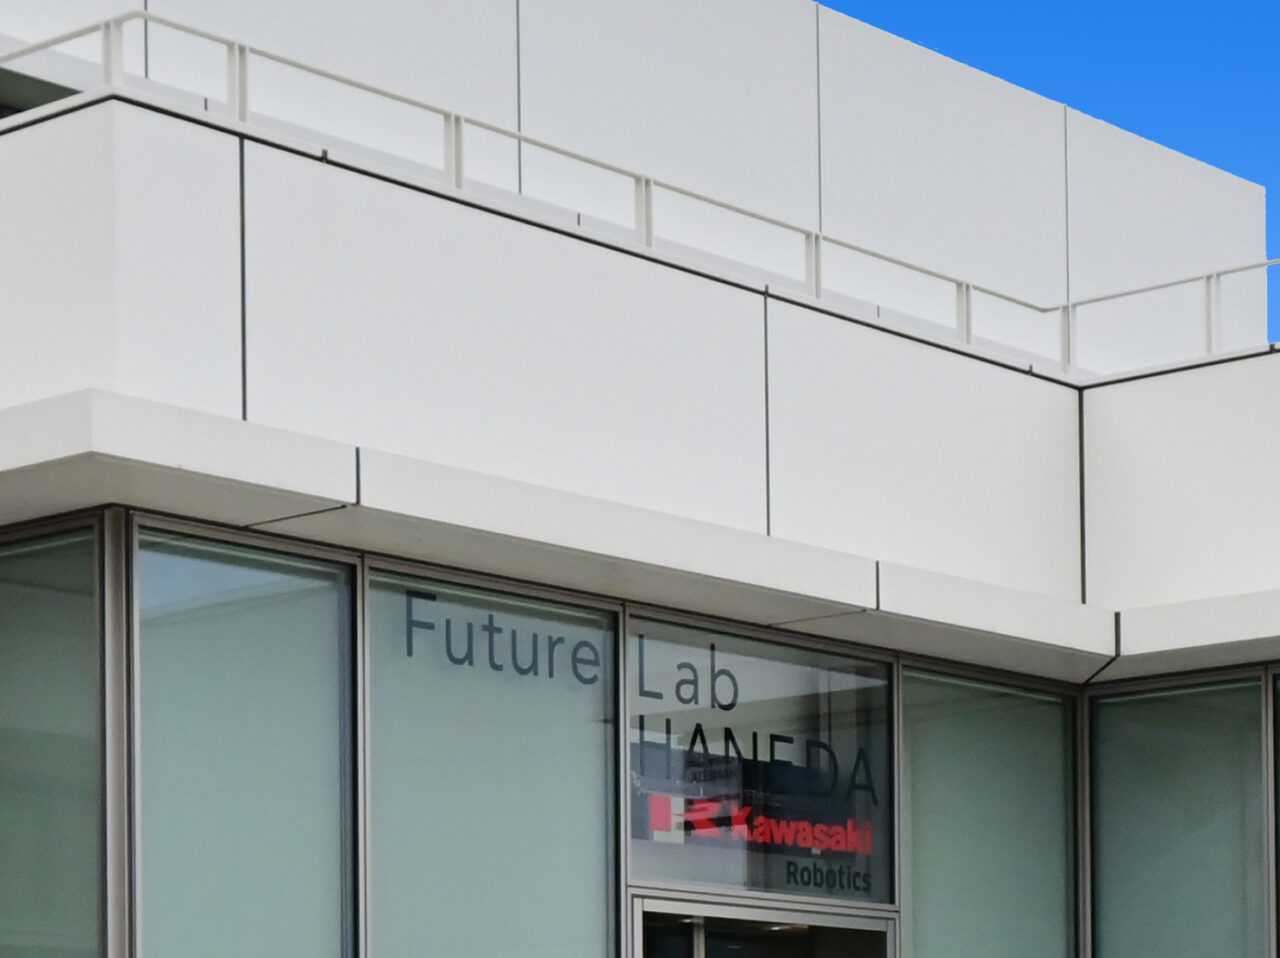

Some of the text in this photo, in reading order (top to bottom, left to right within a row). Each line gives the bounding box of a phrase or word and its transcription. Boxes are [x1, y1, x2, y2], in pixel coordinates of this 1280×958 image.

[405, 589, 739, 711] Future Lab
[638, 714, 880, 806] HANEDA
[731, 804, 873, 856] Kawasaki
[786, 860, 871, 893] Robotics
